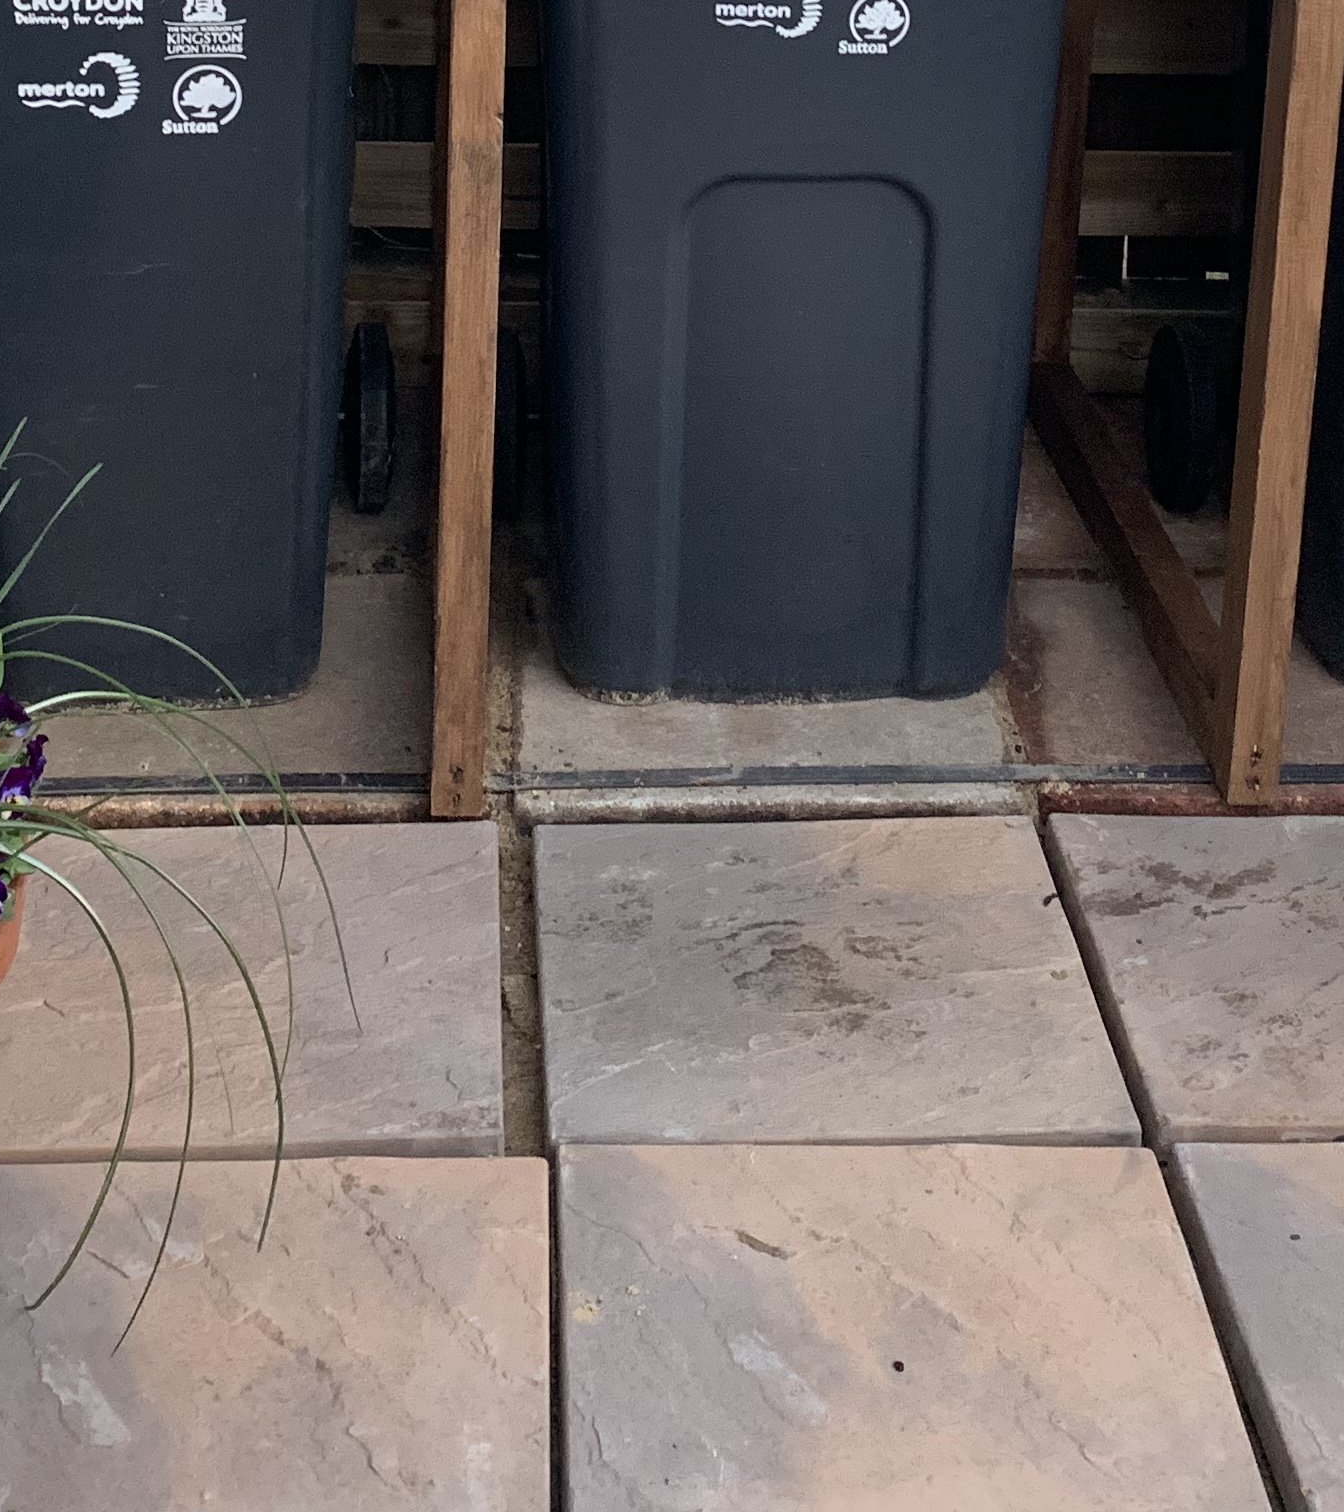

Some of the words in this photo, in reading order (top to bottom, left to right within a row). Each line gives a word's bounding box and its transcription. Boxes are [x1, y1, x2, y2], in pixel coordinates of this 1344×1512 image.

[715, 2, 792, 18] merton
[14, 11, 69, 30] Delivering
[73, 12, 92, 25] for
[94, 12, 144, 30] Croydon
[166, 31, 244, 45] KINGSTON
[166, 44, 200, 54] UPON
[201, 43, 244, 54] THAMES
[838, 40, 889, 54] Sutton
[18, 81, 105, 97] merton
[162, 119, 219, 135] Sutton
